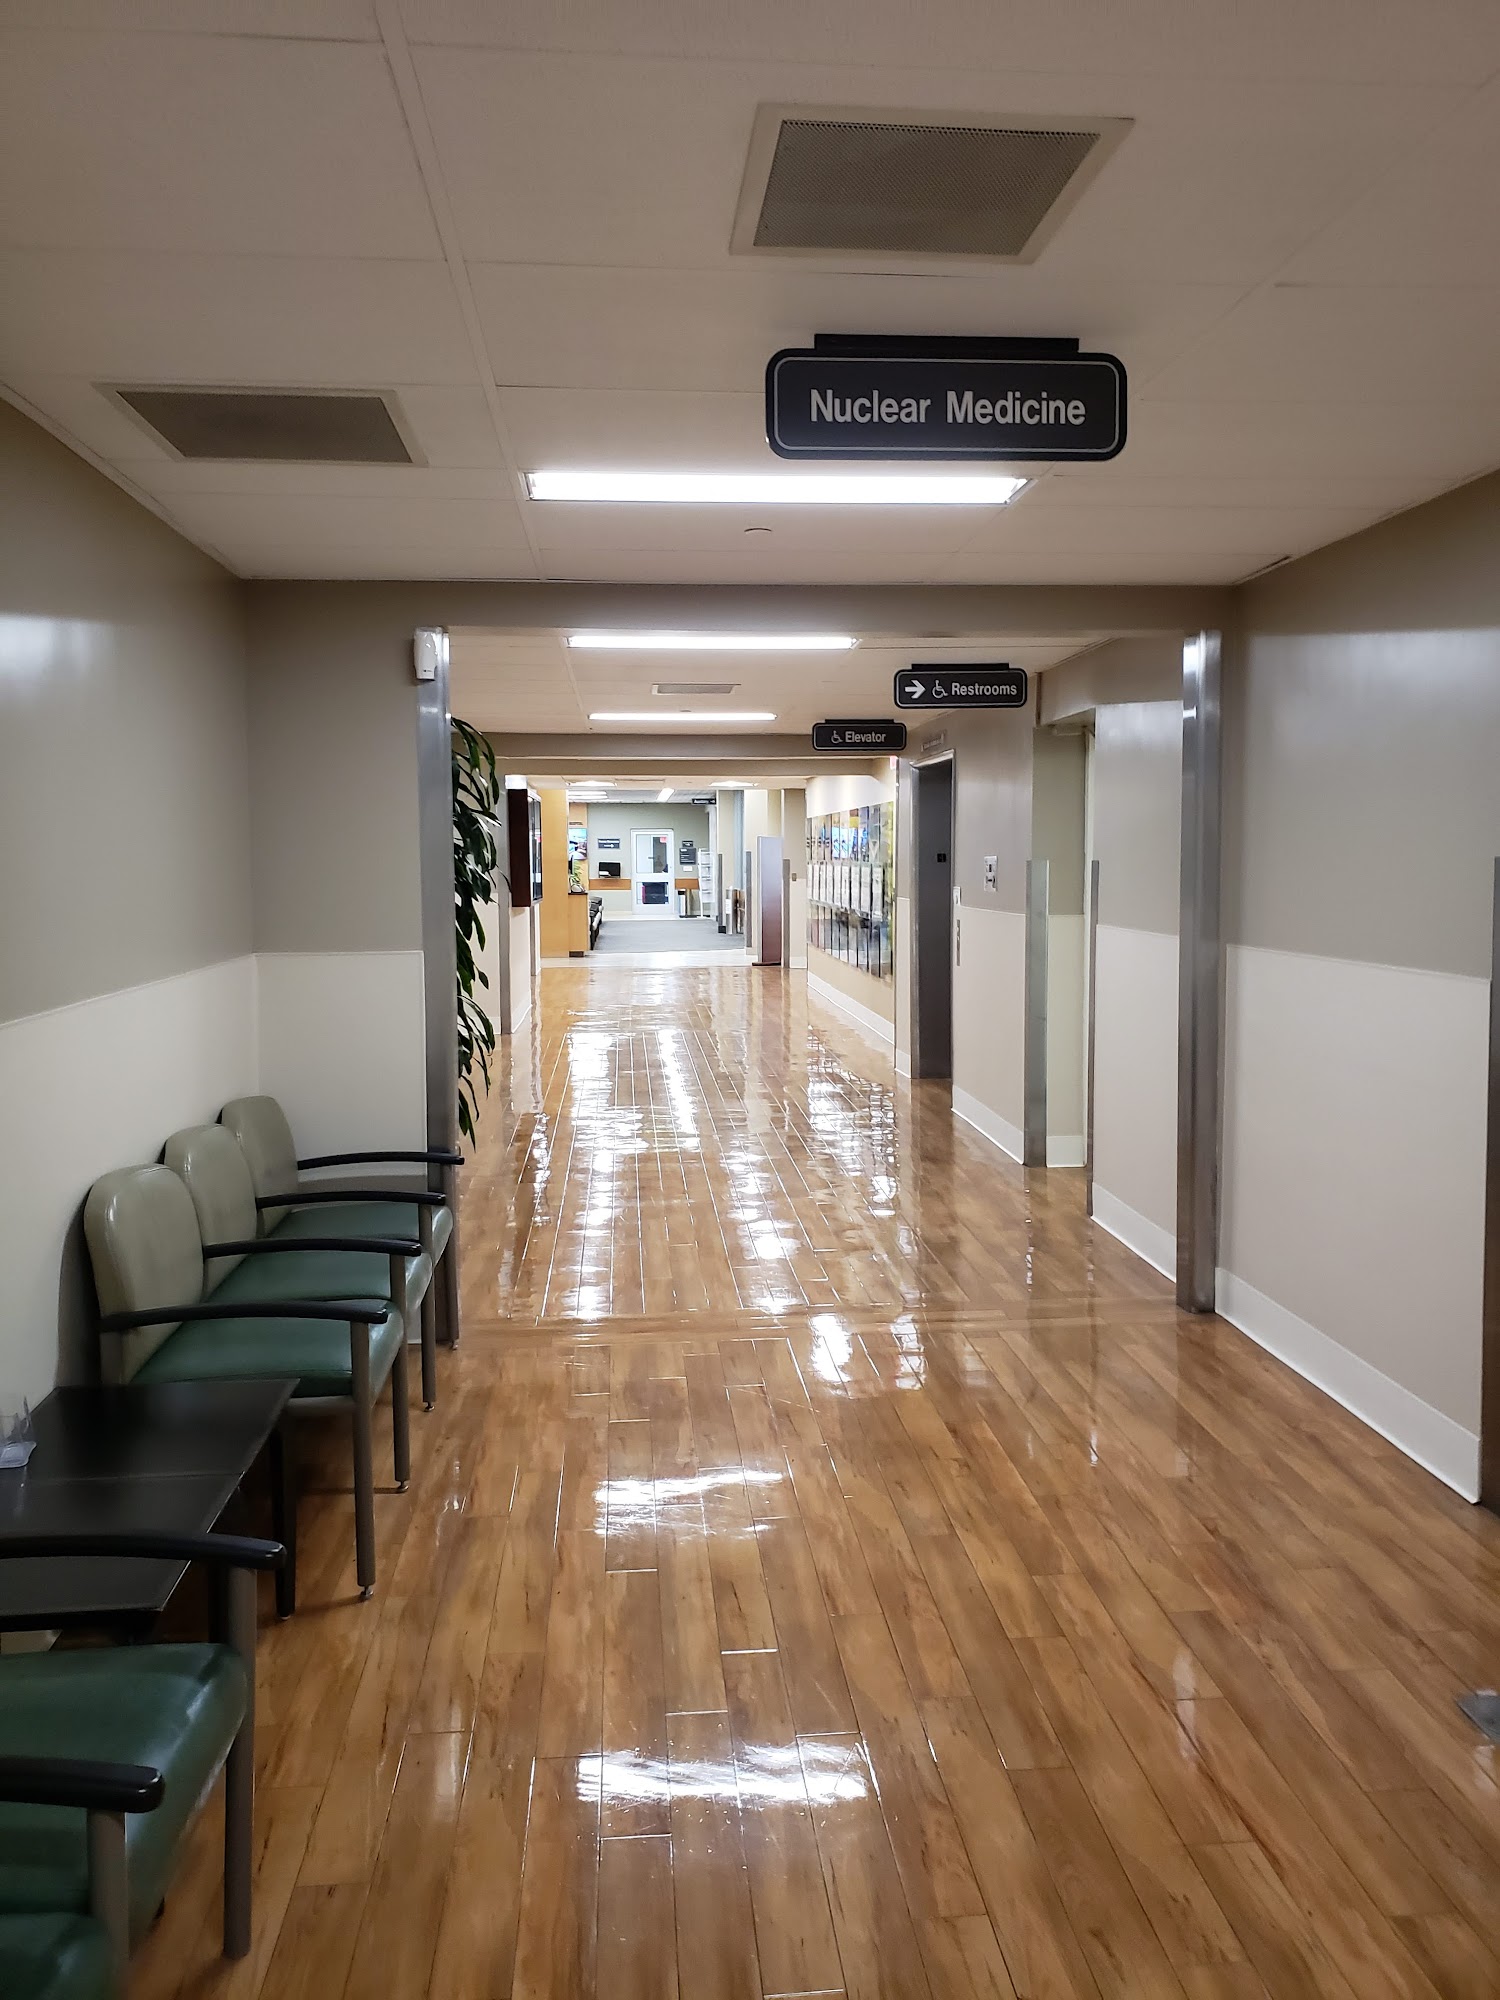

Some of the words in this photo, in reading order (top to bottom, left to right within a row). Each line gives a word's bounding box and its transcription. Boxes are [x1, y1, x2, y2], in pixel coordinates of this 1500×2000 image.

[810, 389, 931, 423] Nuclear
[946, 390, 1086, 425] Medicine
[951, 682, 1017, 696] Restrooms
[845, 731, 886, 743] Elevator
